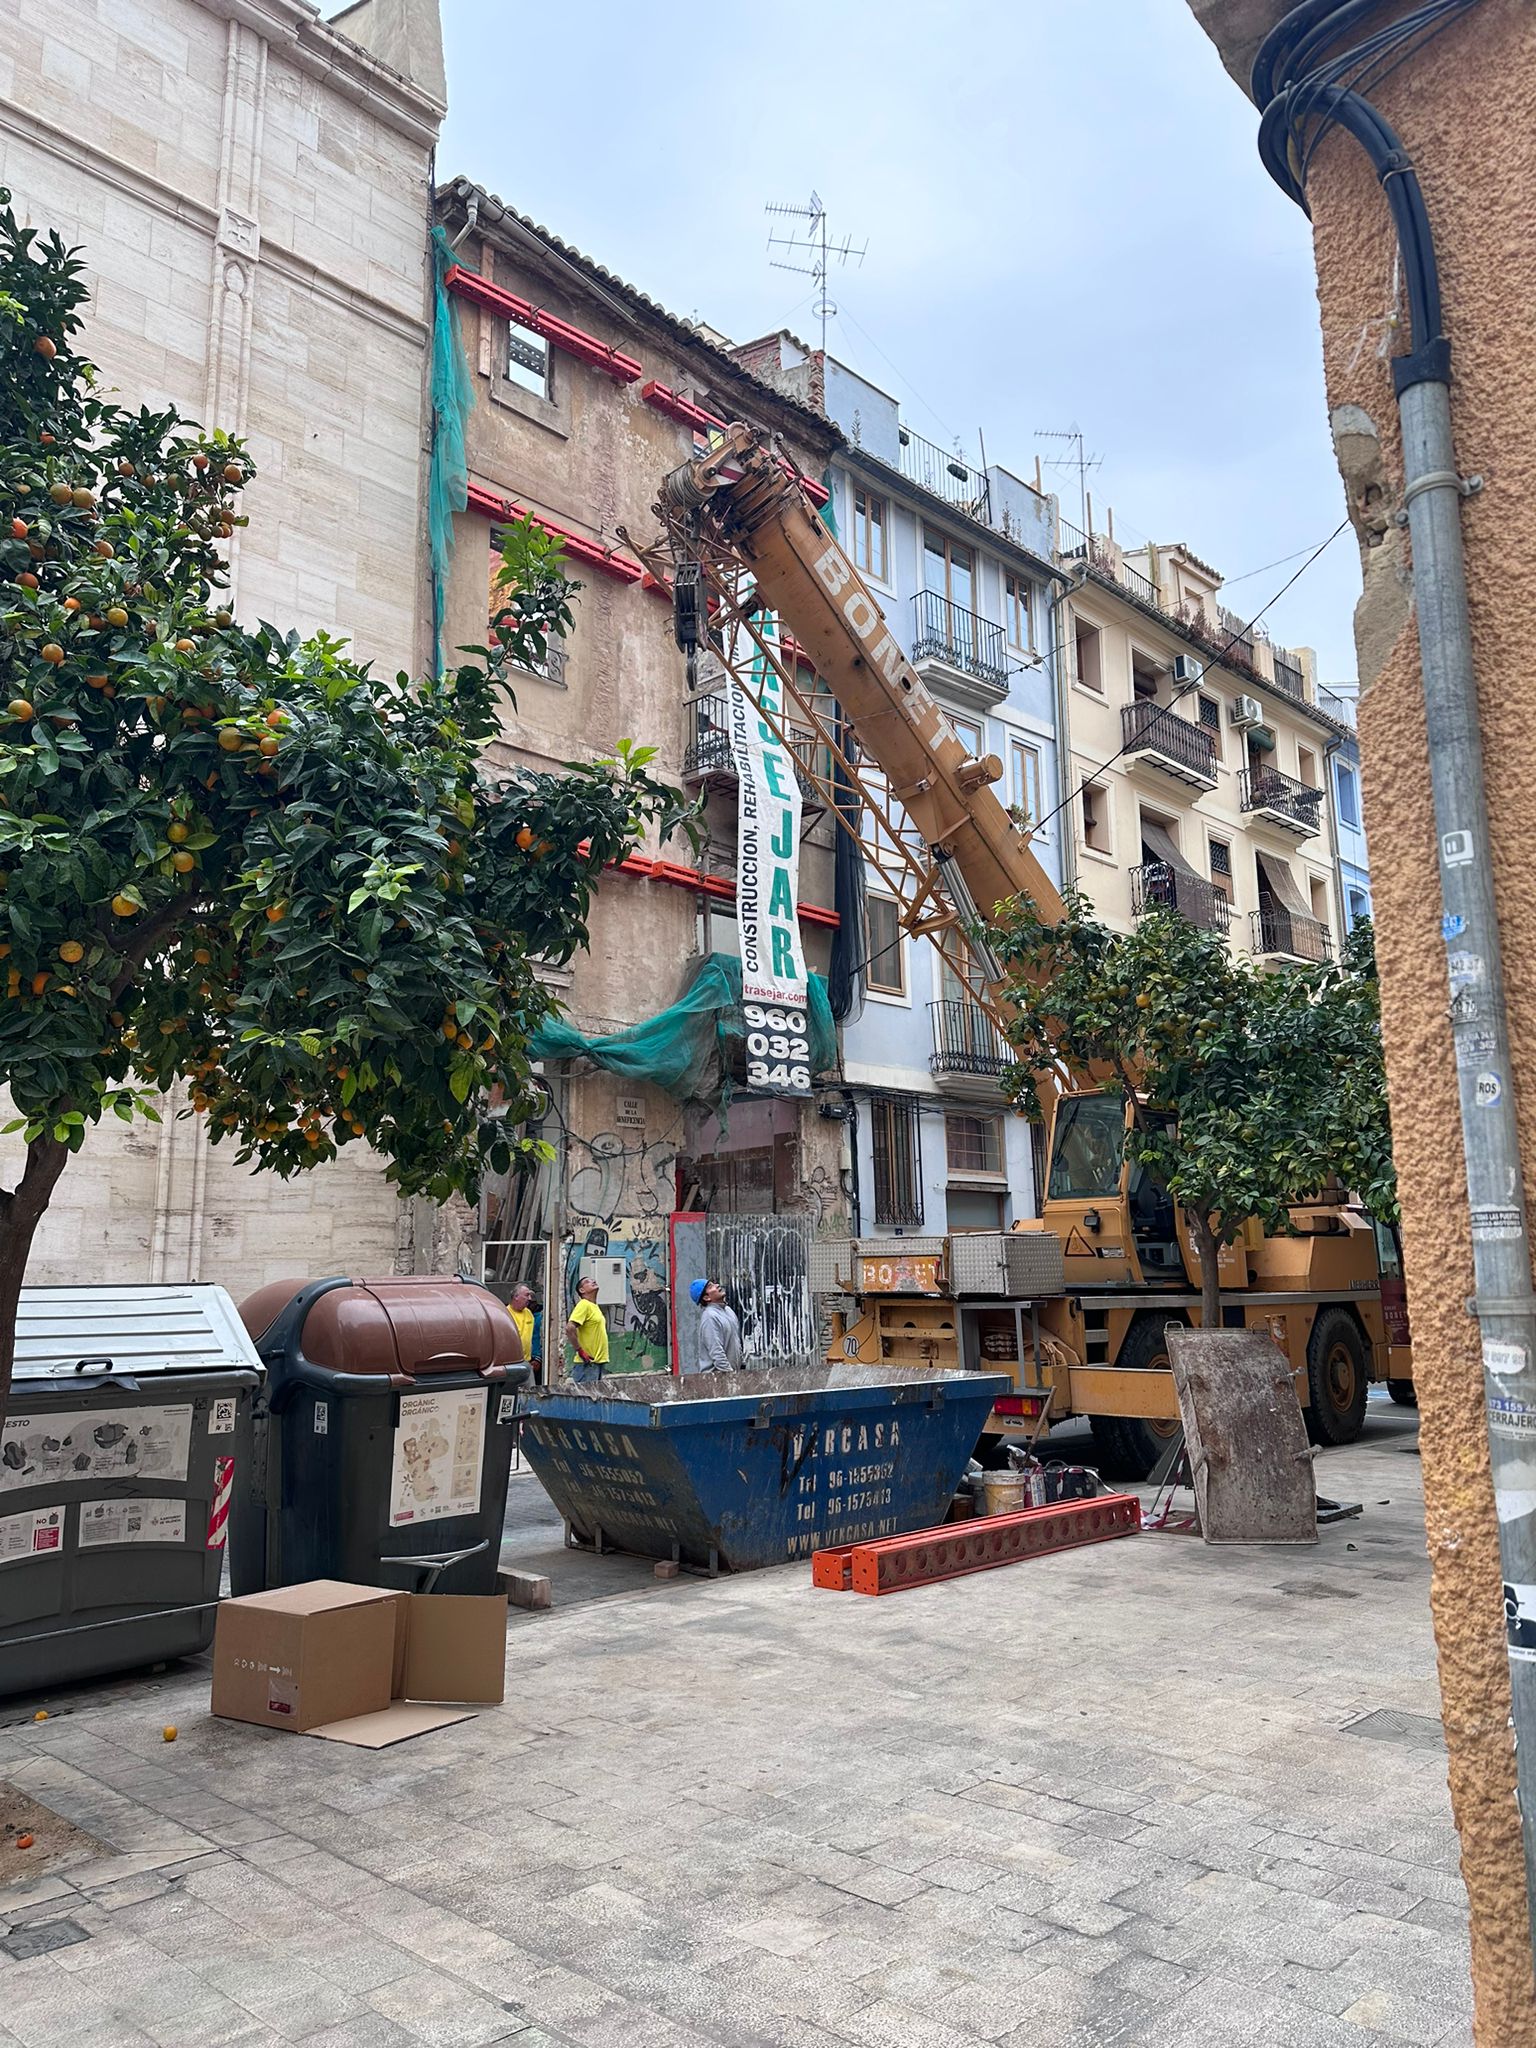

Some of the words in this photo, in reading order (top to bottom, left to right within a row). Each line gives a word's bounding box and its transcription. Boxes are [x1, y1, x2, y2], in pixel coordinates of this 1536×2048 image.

[813, 545, 956, 751] BONET
[744, 983, 807, 1003] trasejar.com
[743, 1004, 807, 1034] 960
[747, 1033, 810, 1061] 032
[747, 1061, 811, 1089] 346
[1479, 1082, 1497, 1095] ROS
[623, 1100, 638, 1108] CALLE
[863, 1263, 937, 1285] BOET
[846, 1337, 857, 1355] 70
[5, 1419, 30, 1428] ESTO
[529, 1424, 640, 1459] VERCASA
[793, 1421, 900, 1461] VERCASA
[797, 1501, 815, 1521] Tel
